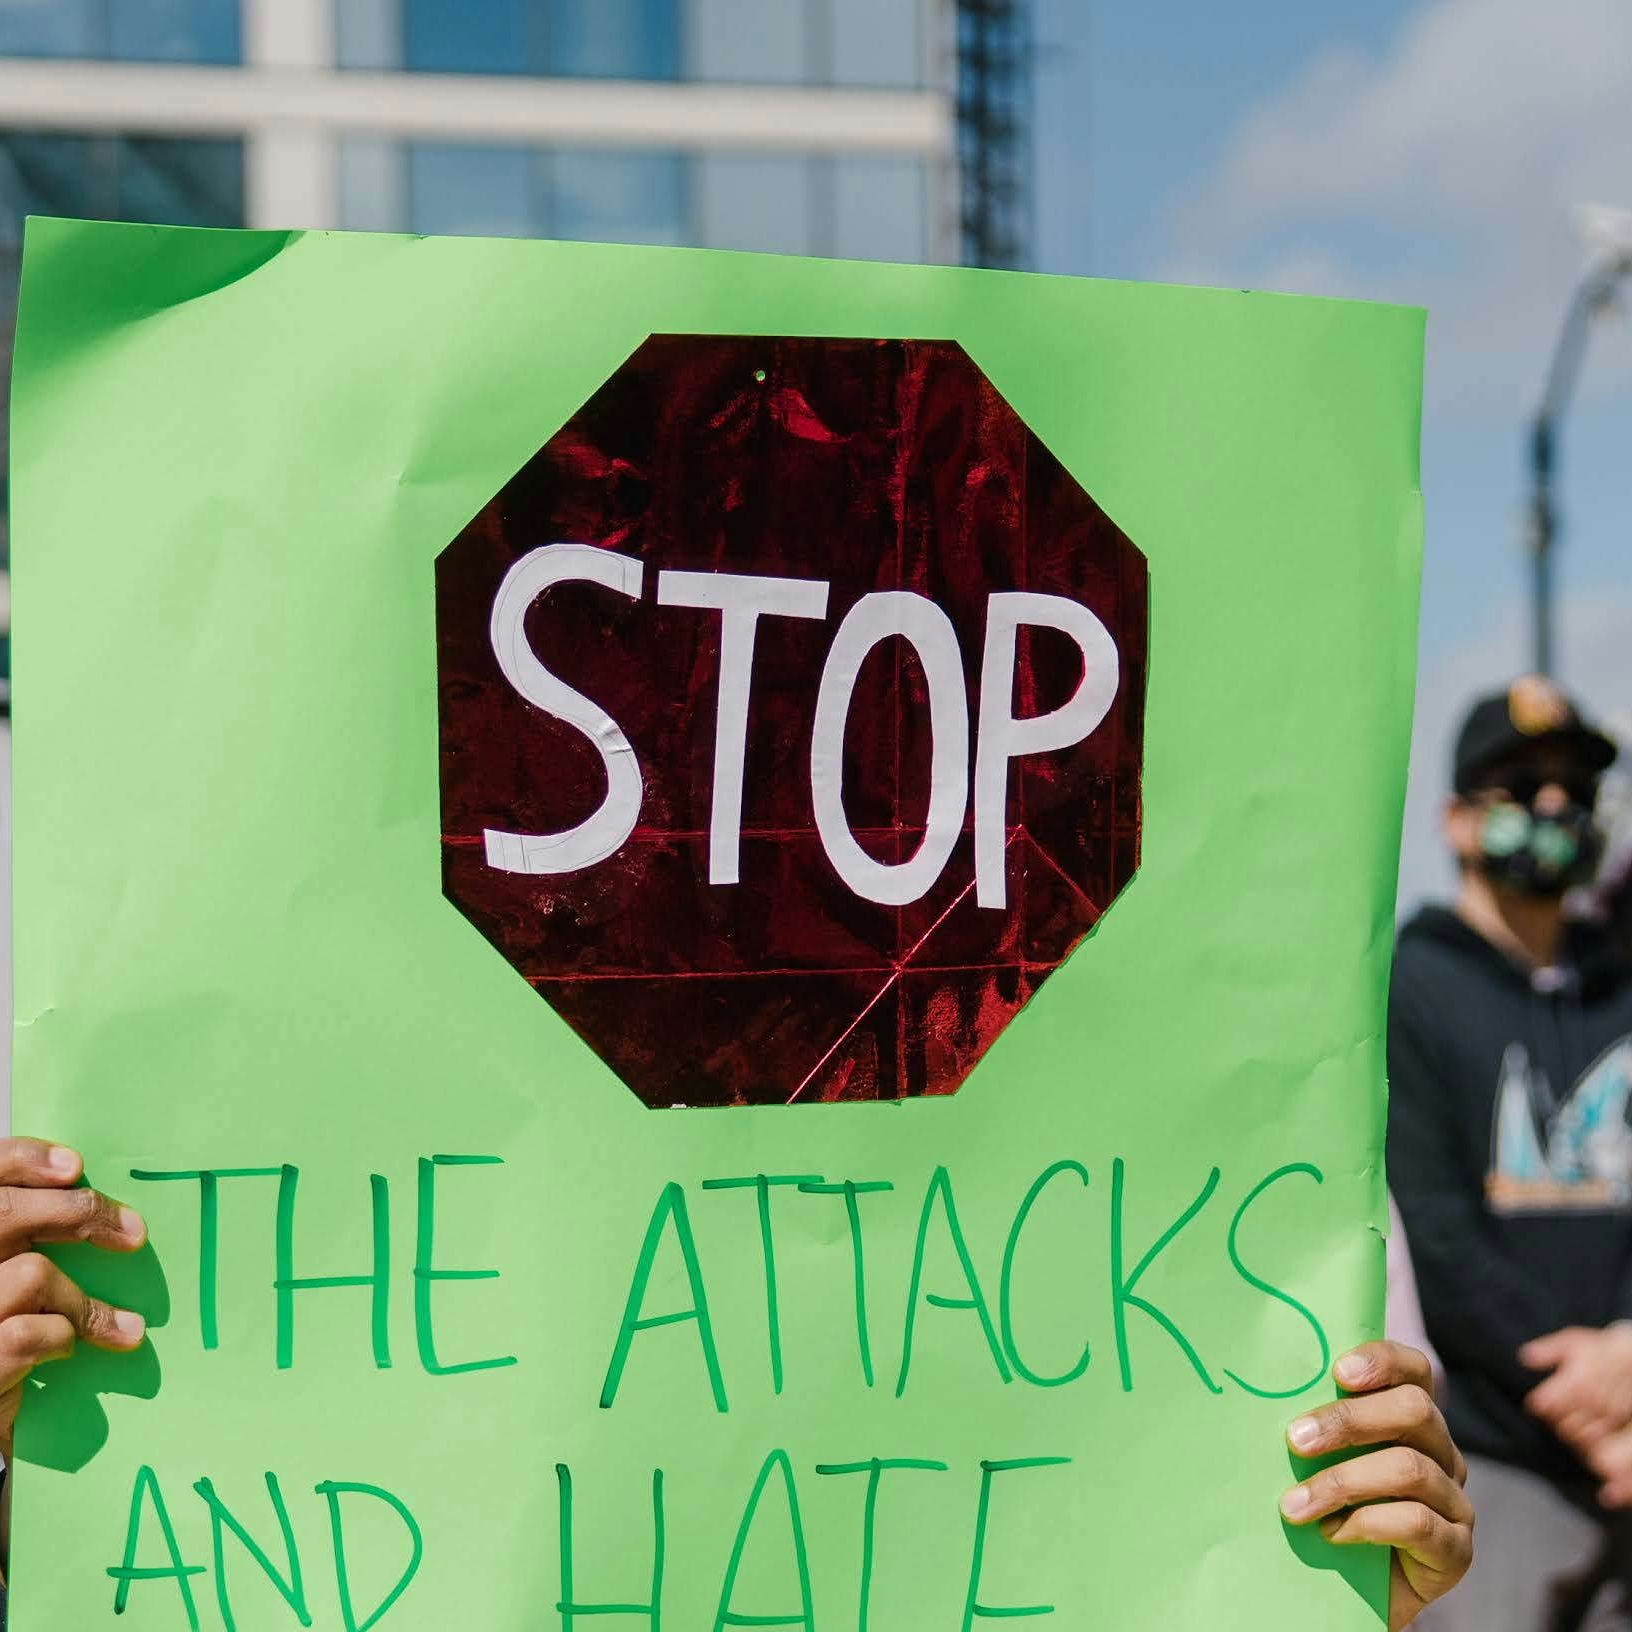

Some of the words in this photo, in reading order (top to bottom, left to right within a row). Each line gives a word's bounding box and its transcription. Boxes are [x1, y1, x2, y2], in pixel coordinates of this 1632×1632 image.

[485, 545, 1119, 909] STOP
[132, 1153, 517, 1376] THE
[600, 1157, 1329, 1413] ATTACKS
